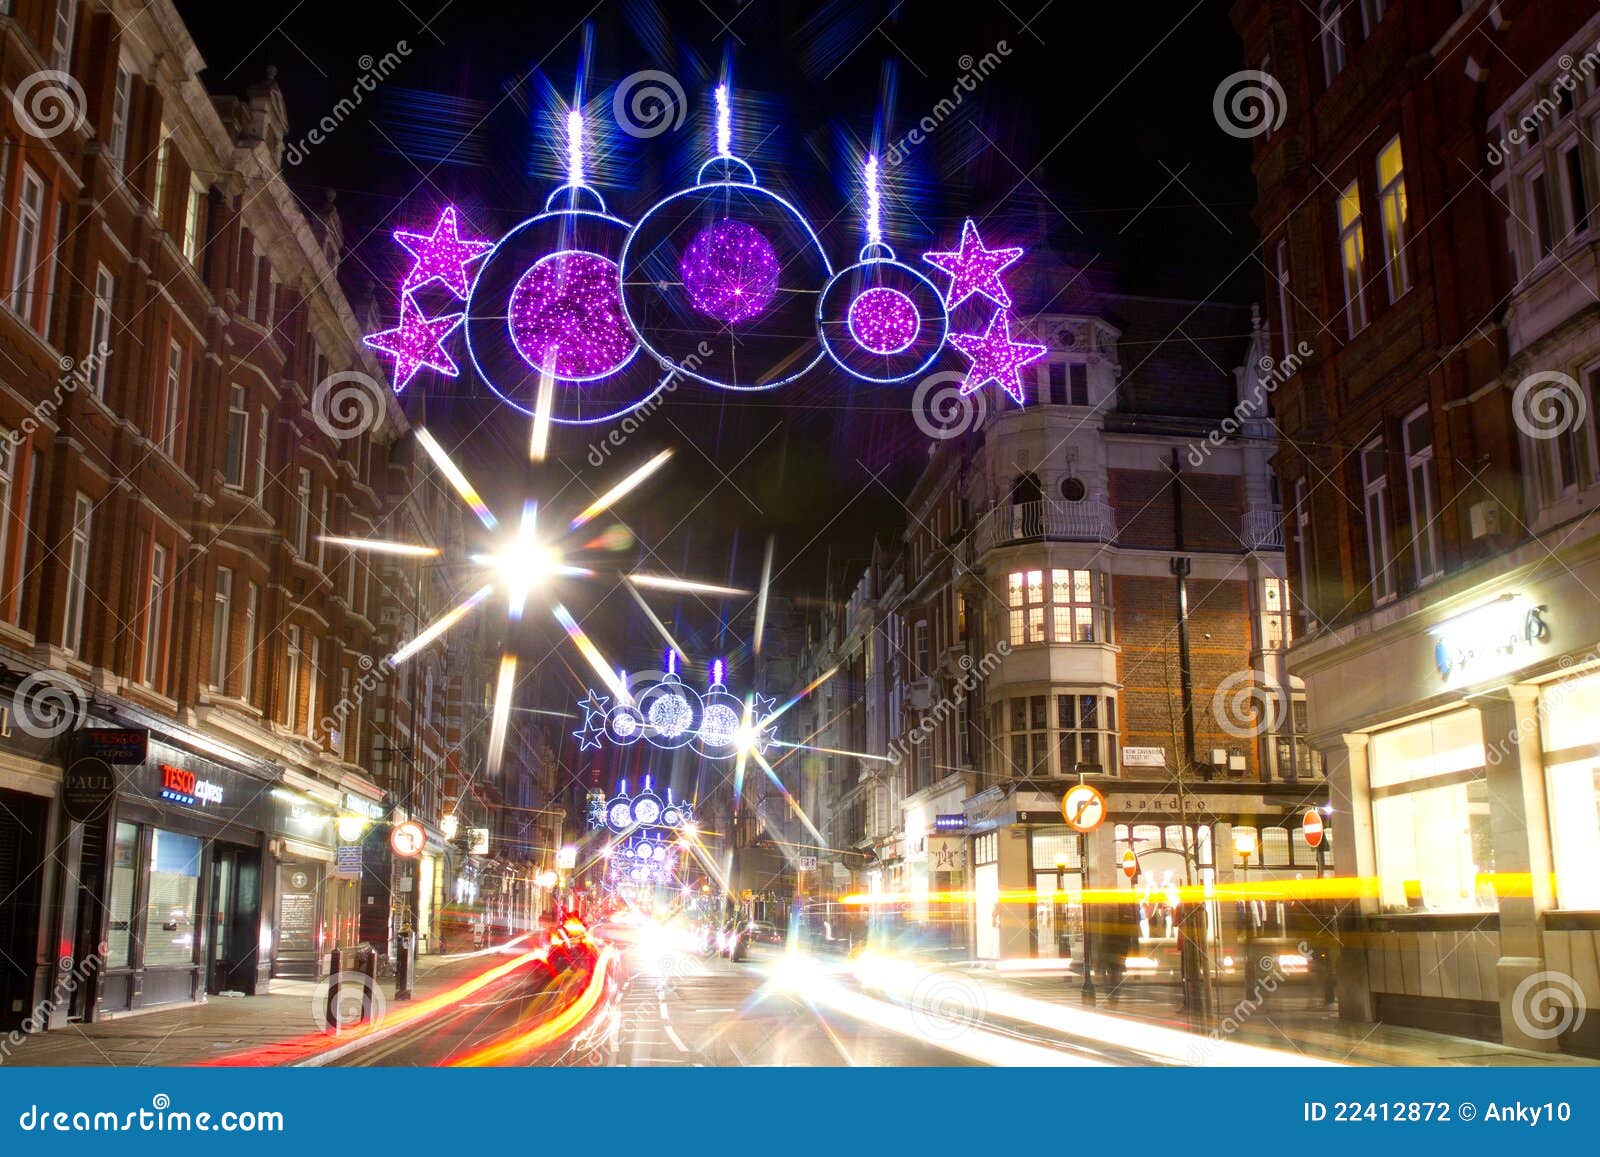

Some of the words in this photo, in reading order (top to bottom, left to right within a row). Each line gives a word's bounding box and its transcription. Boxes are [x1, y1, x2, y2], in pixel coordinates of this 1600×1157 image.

[91, 732, 141, 744] TESCO
[65, 775, 112, 789] PAUL
[162, 764, 196, 796] TESCO
[195, 779, 224, 807] express
[1125, 797, 1206, 809] sandro
